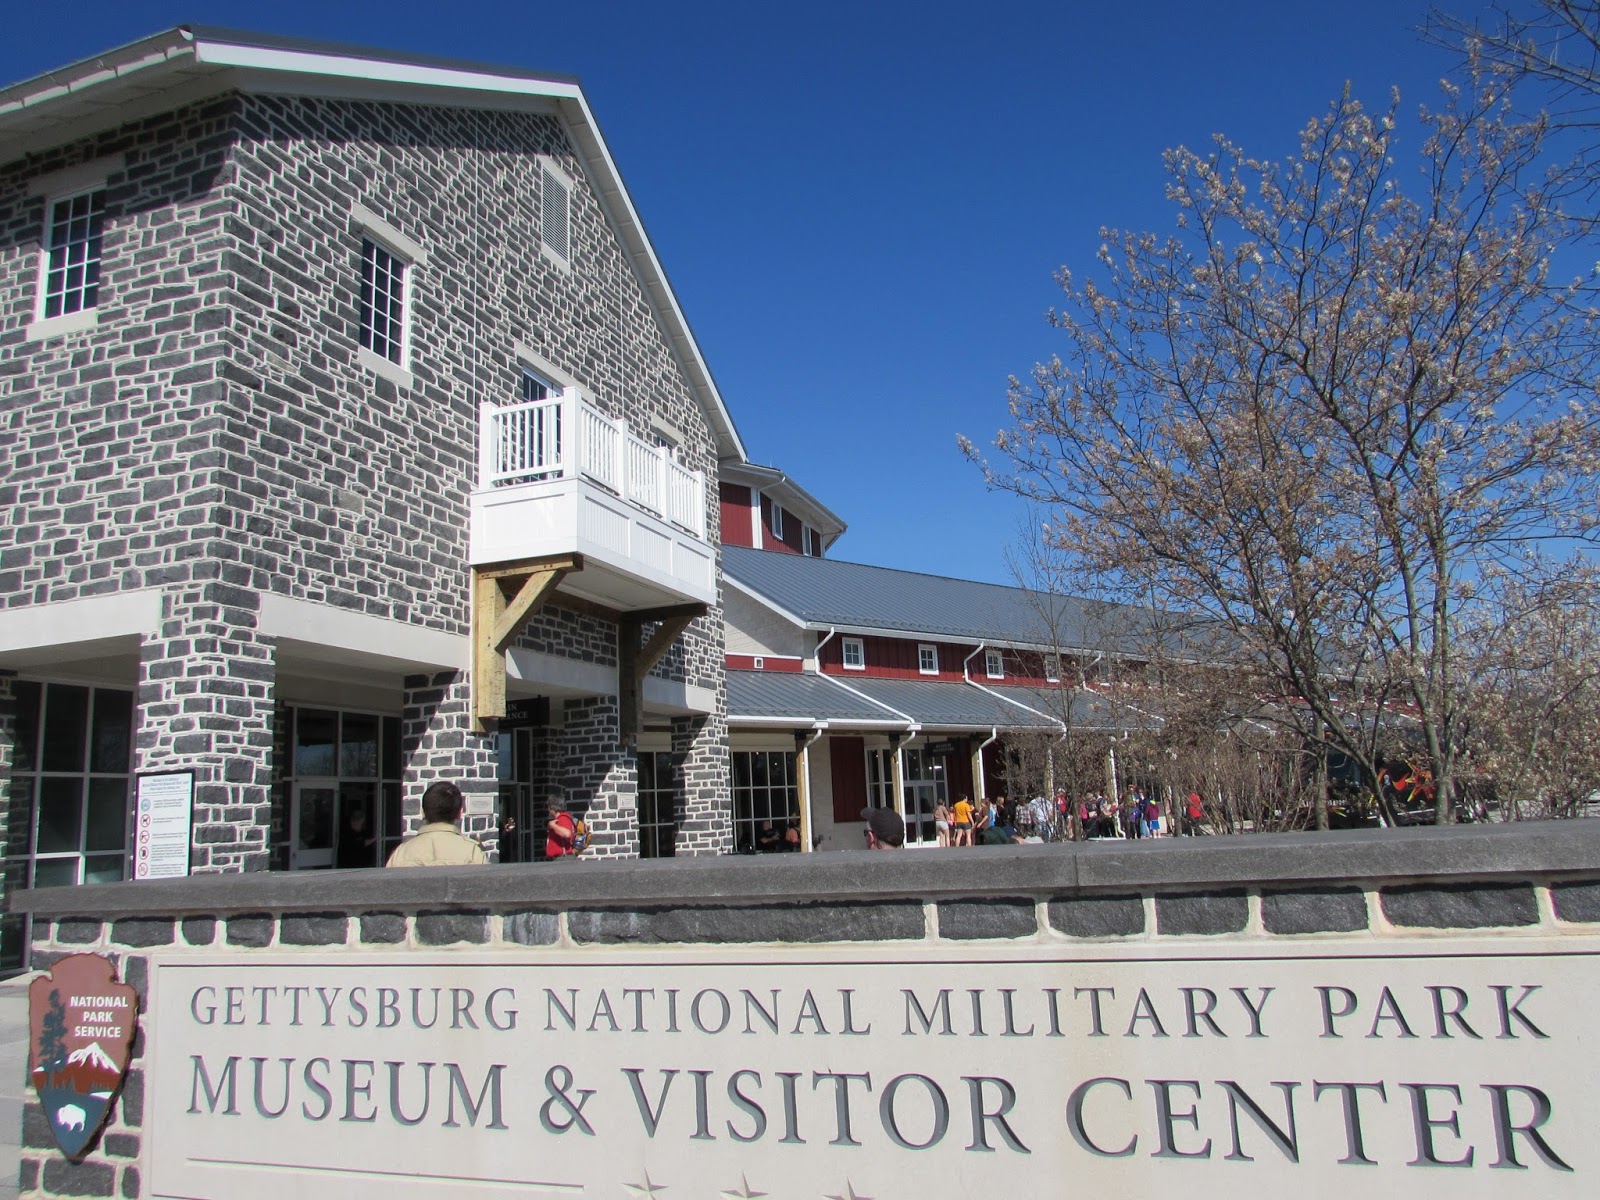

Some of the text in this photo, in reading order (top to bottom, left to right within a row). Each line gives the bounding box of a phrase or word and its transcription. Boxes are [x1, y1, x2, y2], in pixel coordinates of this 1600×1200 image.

[70, 996, 128, 1008] NATIONAL
[83, 1011, 113, 1022] PARK
[190, 985, 1551, 1040] GETTYSBURG NATIONAL MILITARY PARK
[74, 1026, 121, 1038] SERVICE
[185, 1054, 1575, 1173] MUSEUM & VISITOR CENTER
